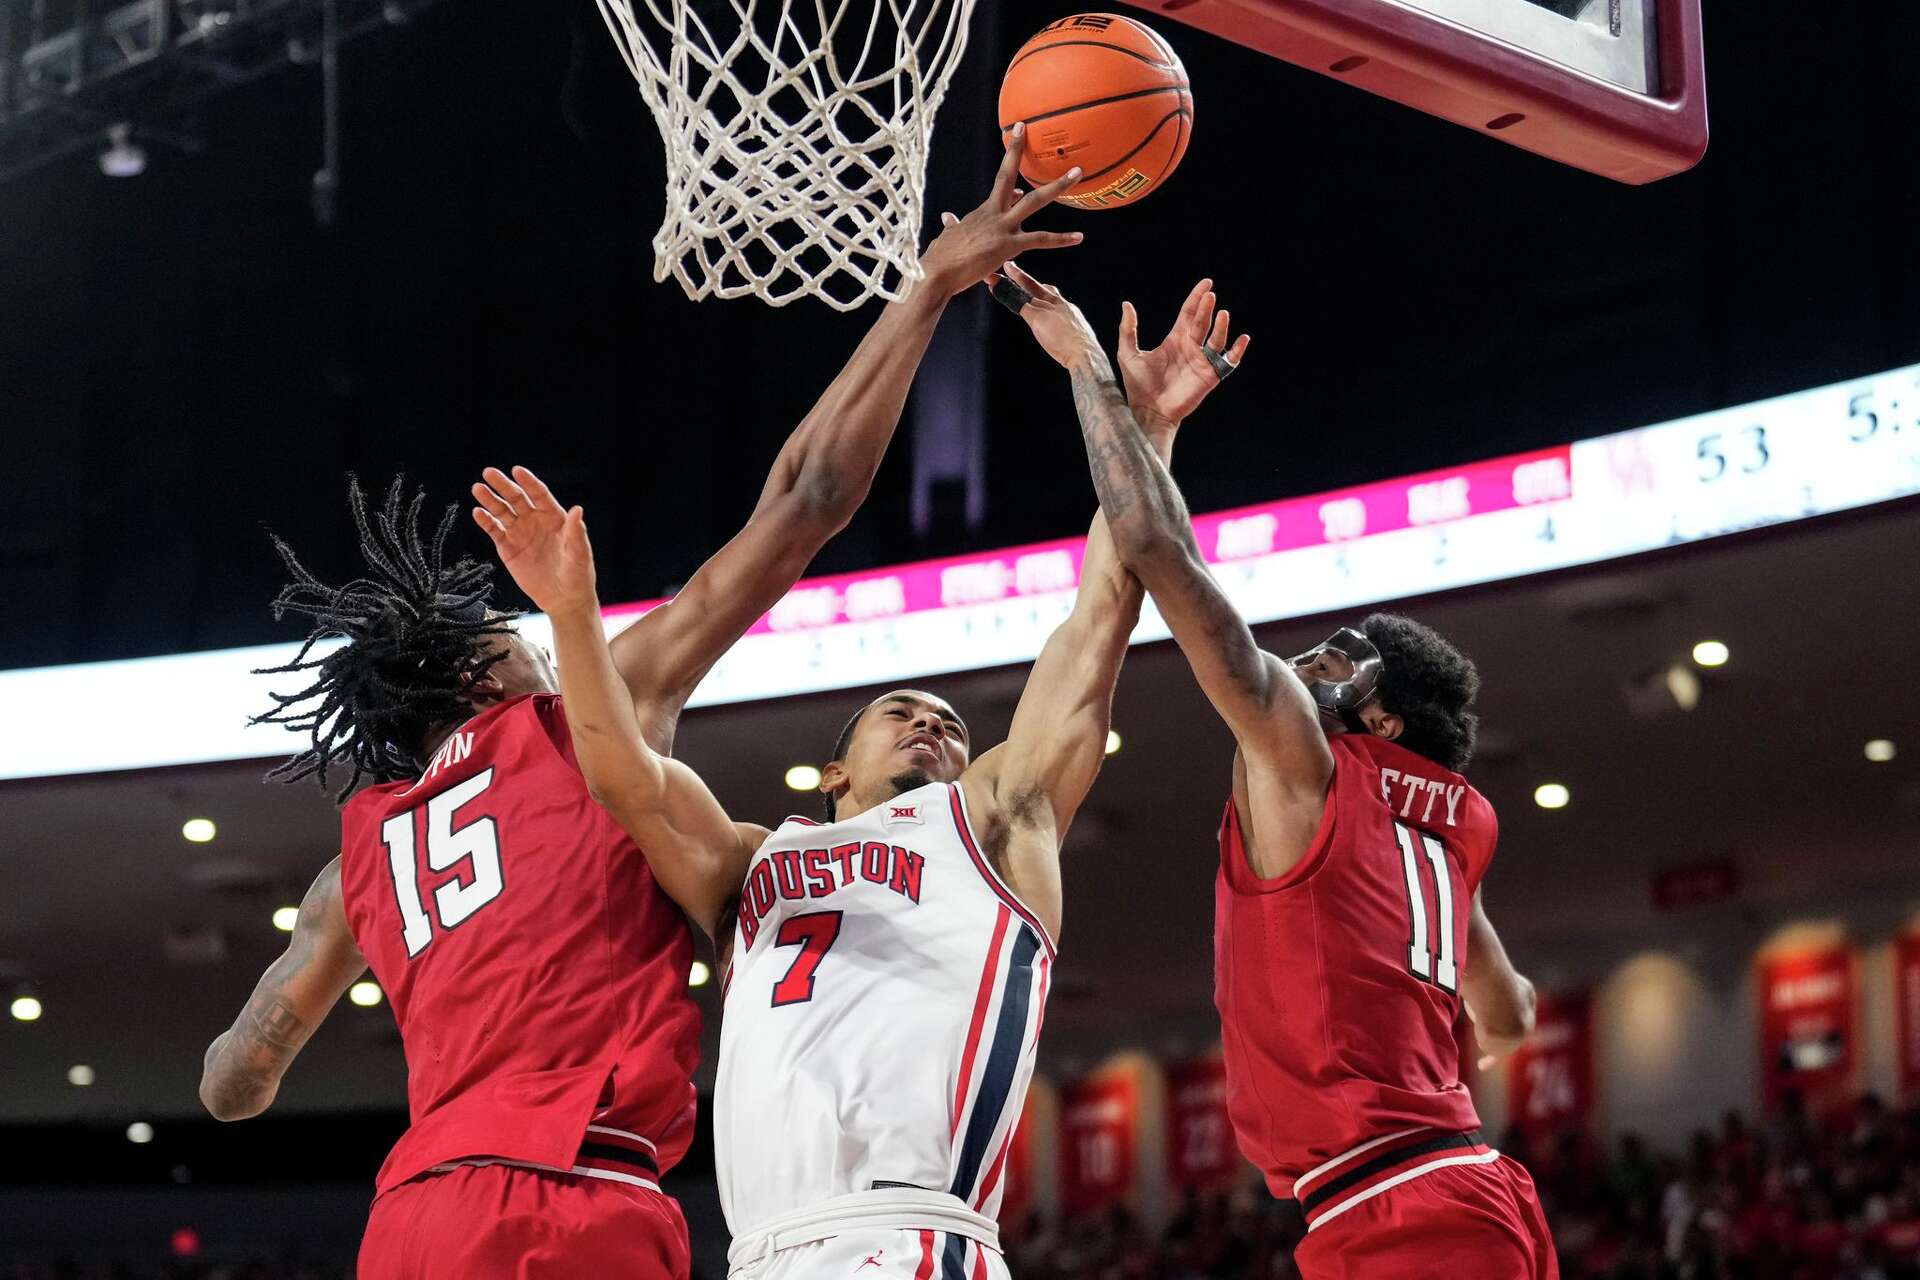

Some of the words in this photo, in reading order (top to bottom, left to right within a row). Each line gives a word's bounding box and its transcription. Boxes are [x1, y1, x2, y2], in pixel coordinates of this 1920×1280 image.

[1697, 425, 1770, 482] 53
[1849, 374, 1920, 442] 5:
[381, 764, 505, 960] 15
[739, 841, 925, 954] HOUSTON
[1393, 819, 1458, 996] 11
[771, 910, 844, 1008] 7
